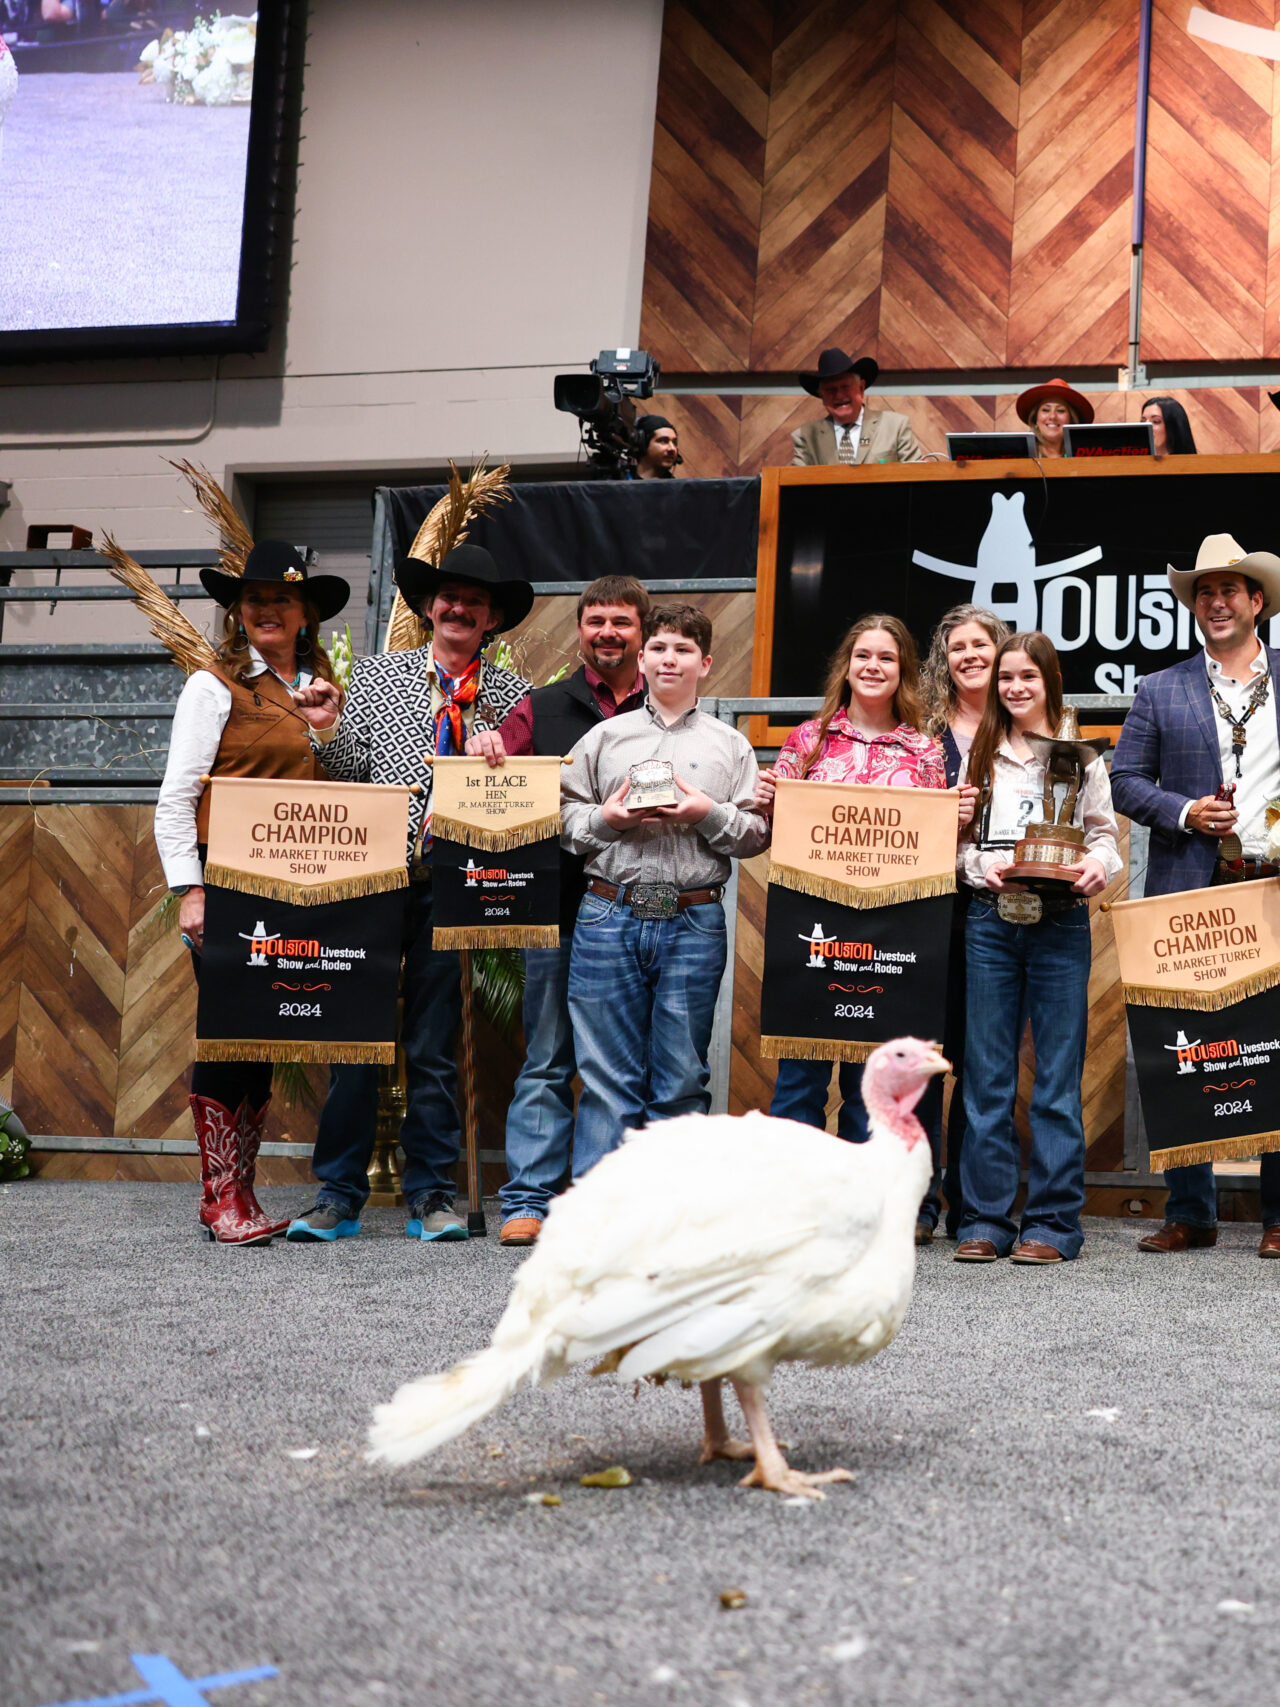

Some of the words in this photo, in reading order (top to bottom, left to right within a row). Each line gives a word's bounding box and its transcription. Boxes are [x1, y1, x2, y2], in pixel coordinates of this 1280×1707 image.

[484, 776, 527, 787] PLACE
[486, 791, 507, 799] HEN
[274, 802, 348, 823] GRAND
[832, 805, 901, 827] GRAND
[1017, 800, 1034, 827] 2
[251, 823, 367, 846] CHAMPION
[811, 826, 918, 849] CHAMPION
[249, 848, 265, 859] JR.
[269, 849, 318, 861] MARKET
[322, 850, 368, 862] TURKEY
[808, 851, 823, 860] JR.
[827, 852, 872, 863] MARKET
[876, 853, 919, 866] TURKEY
[290, 863, 327, 874] SHOW
[846, 865, 880, 877] SHOW
[485, 908, 510, 916] 2024
[1169, 908, 1235, 934] GRAND
[1154, 925, 1257, 957] CHAMPION
[321, 946, 365, 959] Livestock
[874, 950, 916, 962] Livestock
[277, 958, 304, 970] Show
[305, 959, 321, 971] and
[321, 960, 351, 971] Rodeo
[834, 960, 858, 972] Show
[859, 962, 873, 972] and
[874, 963, 902, 974] Rodeo
[1156, 962, 1170, 974] JR.
[1174, 956, 1216, 972] MARKET
[1221, 948, 1261, 964] TURKEY
[1194, 968, 1227, 981] SHOW
[279, 1003, 322, 1017] 2024
[835, 1004, 874, 1018] 2024
[1239, 1039, 1280, 1054] Livestock
[1204, 1061, 1226, 1072] Show
[1228, 1058, 1242, 1068] and
[1243, 1055, 1270, 1066] Rodeo
[1214, 1100, 1252, 1116] 2024
